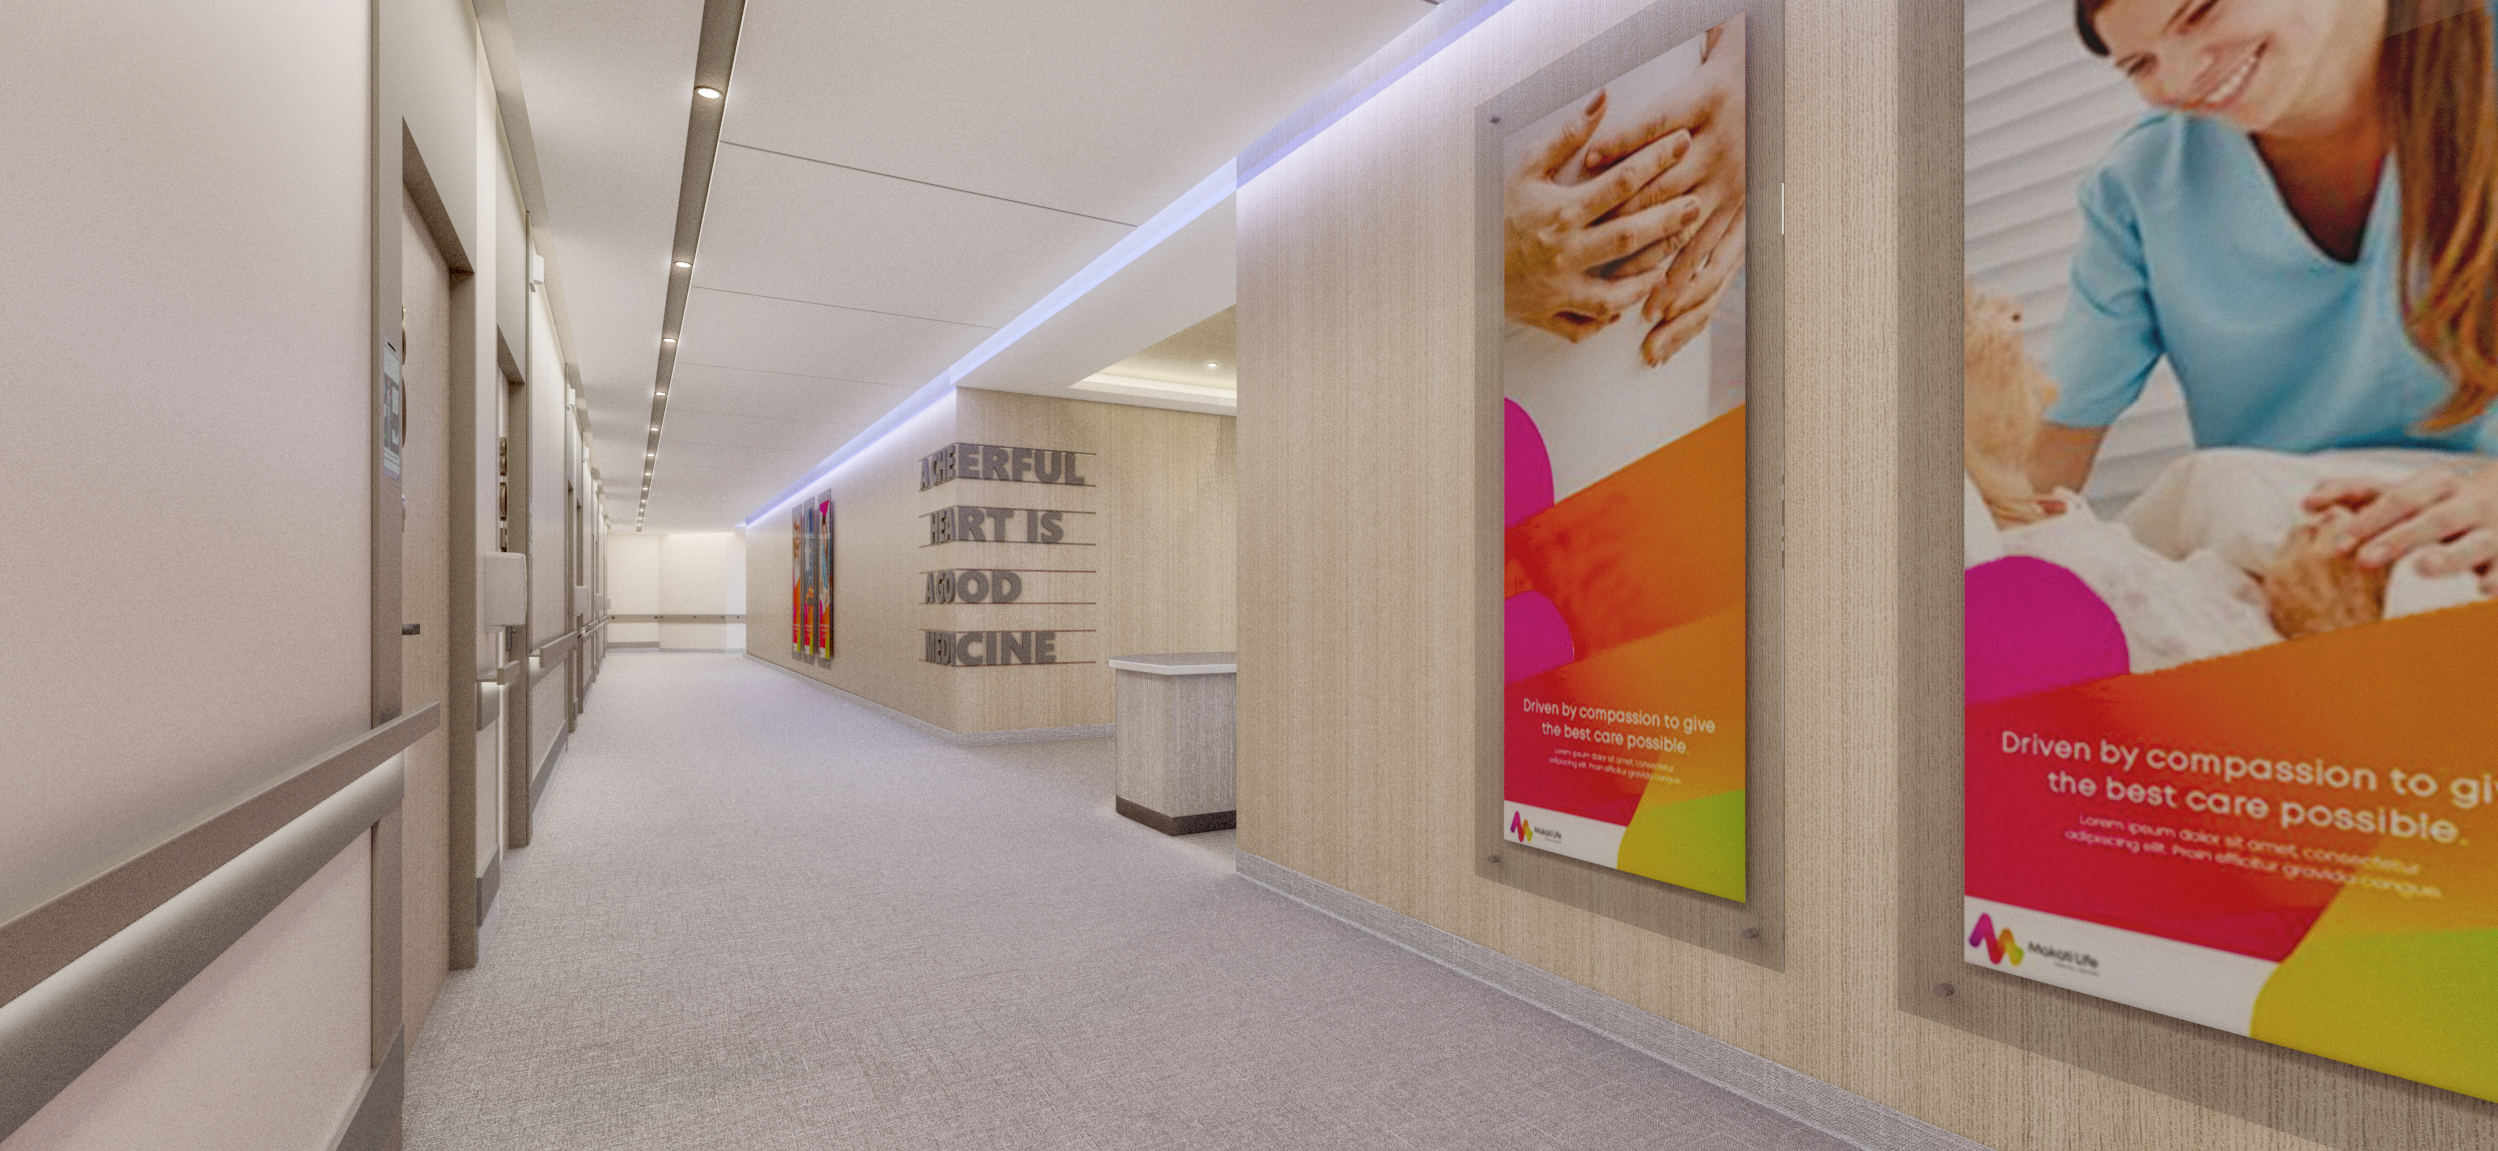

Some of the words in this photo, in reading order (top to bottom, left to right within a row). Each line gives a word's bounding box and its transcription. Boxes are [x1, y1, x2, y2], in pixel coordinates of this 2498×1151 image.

[920, 458, 930, 490] A
[931, 444, 1085, 485] CHEERFUL
[930, 507, 1014, 544] HEART
[1027, 510, 1064, 544] IS
[925, 572, 935, 604] A
[936, 570, 1022, 604] GOOD
[925, 631, 1056, 667] MEDICINE
[1523, 698, 1559, 715] Driven
[1562, 701, 1577, 721] by
[1579, 706, 1660, 727] compassion
[1664, 713, 1680, 729] to
[1683, 714, 1716, 735] give
[1541, 721, 1561, 736] the
[1564, 723, 1591, 741] best
[1593, 730, 1624, 745] care
[1627, 734, 1690, 755] possible.
[2002, 730, 2091, 761] Driven
[2100, 738, 2140, 772] by
[2146, 748, 2377, 791] compassion
[2390, 768, 2438, 797] to
[2450, 773, 2498, 809] gi
[2046, 769, 2097, 797] the
[2106, 775, 2178, 809] best
[2185, 789, 2269, 820] care
[2281, 801, 2470, 847] possible.
[2079, 814, 2125, 831] Lorem
